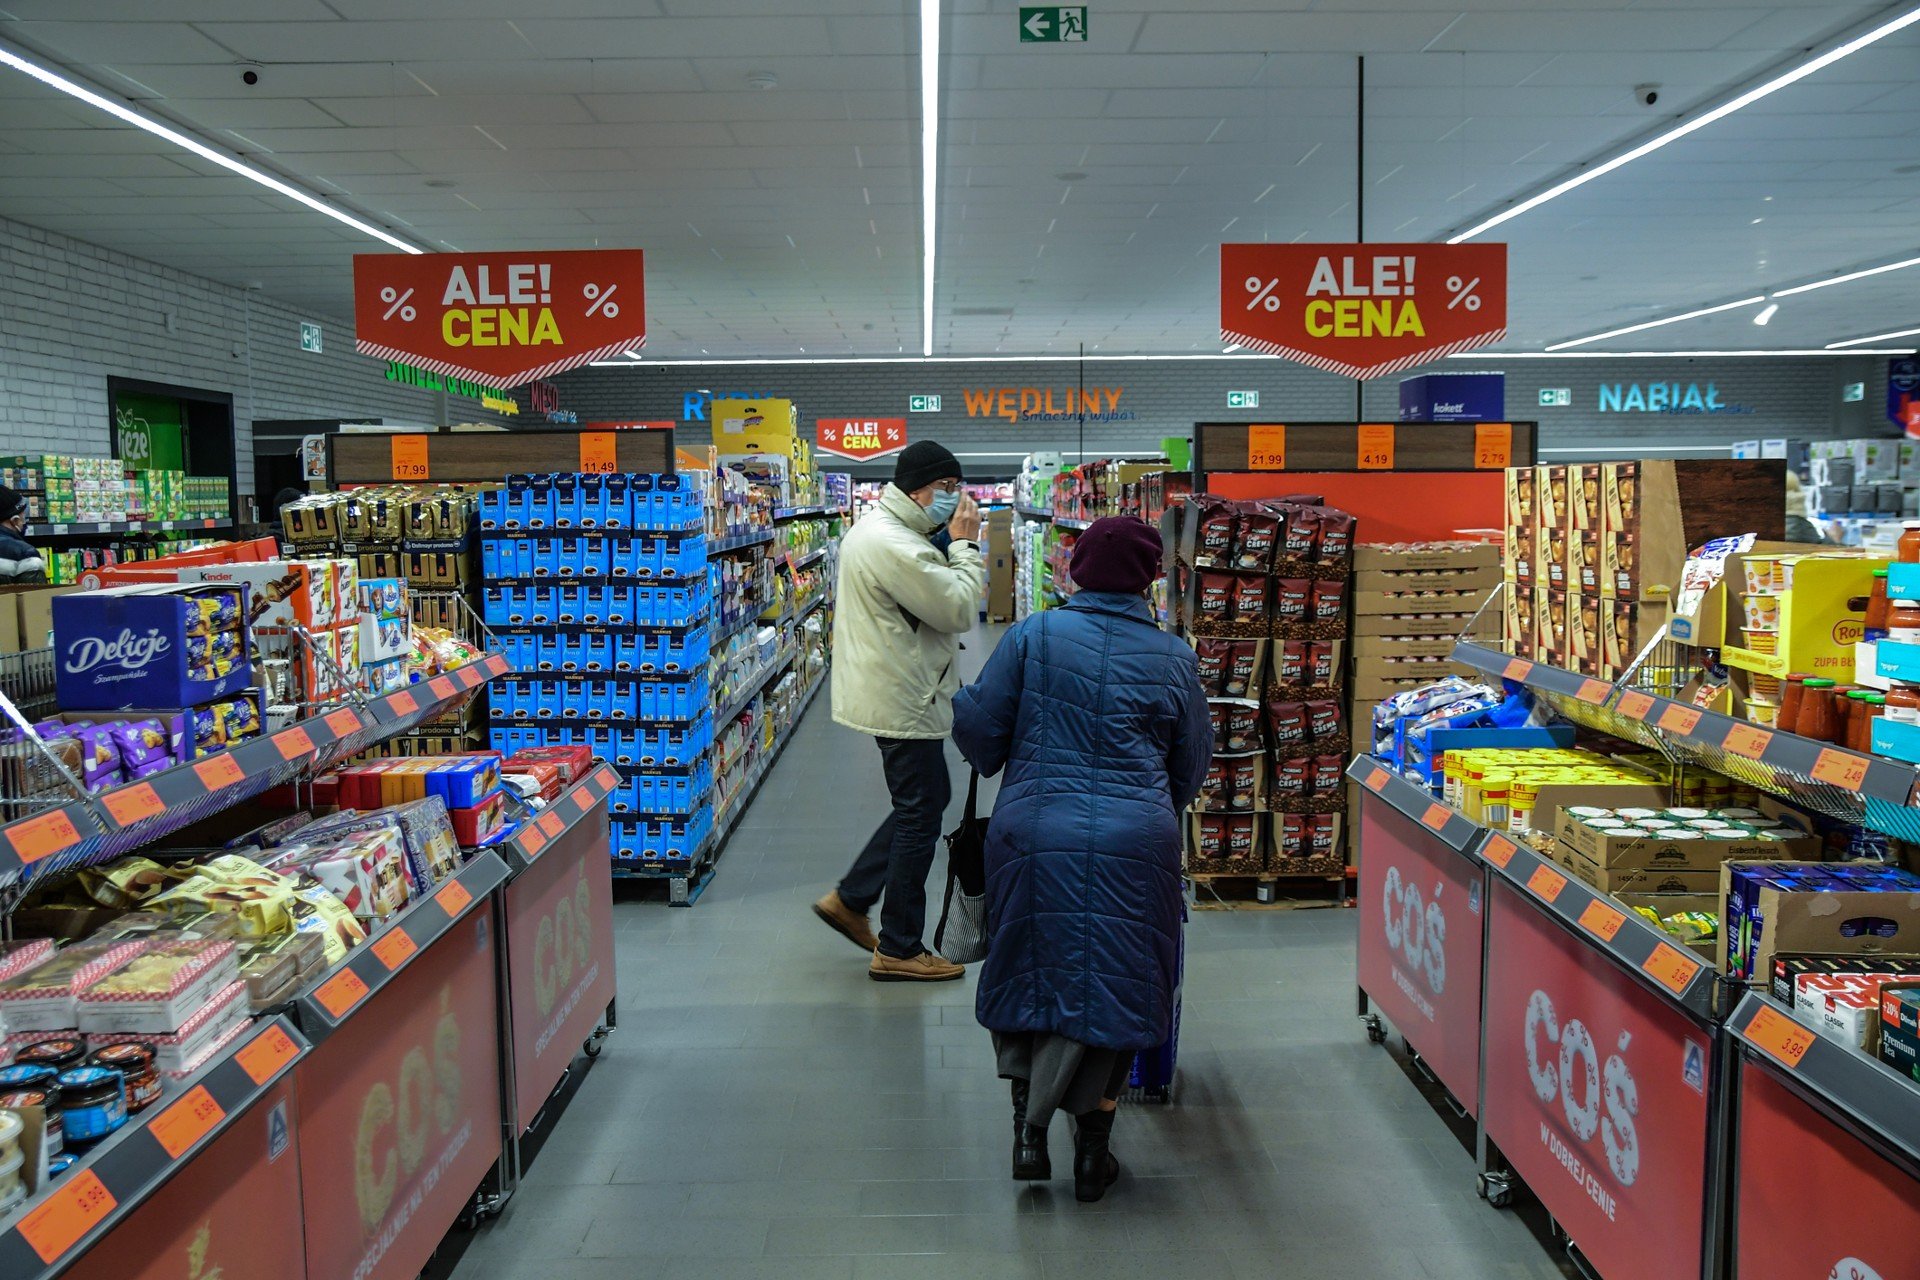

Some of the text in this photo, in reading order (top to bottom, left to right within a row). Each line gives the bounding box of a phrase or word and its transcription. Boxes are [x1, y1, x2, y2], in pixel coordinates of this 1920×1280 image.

[1305, 256, 1416, 297] ALE!
[442, 264, 551, 305] ALE!
[1305, 299, 1426, 338] CENA
[442, 308, 564, 347] CENA
[1599, 380, 1726, 412] NABIAŁ
[962, 386, 1124, 424] WĘDLINY
[843, 422, 878, 436] ALE!
[842, 436, 881, 449] CENA
[583, 462, 615, 473] 11,49
[1251, 455, 1282, 466] 21,99
[395, 464, 426, 476] 17,99
[296, 543, 328, 552] prodomo
[1205, 537, 1229, 545] CREMA
[1322, 545, 1346, 553] CREMA
[1202, 600, 1226, 608] CREMA
[1239, 601, 1263, 610] CREMA
[1280, 605, 1304, 613] CREMA
[1839, 626, 1864, 640] ROL
[65, 628, 171, 674] Delicje
[1814, 657, 1838, 668] ZUPA
[94, 670, 148, 685] Szampańskie
[420, 727, 452, 736] prodomo
[1316, 778, 1339, 787] CREMA
[1843, 768, 1863, 783] 2,49
[1279, 779, 1302, 787] CREMA
[1824, 1014, 1845, 1030] CLASSIC
[1781, 1038, 1804, 1058] 3,99
[1883, 1030, 1916, 1058] Premium
[1884, 1042, 1896, 1058] Tea
[1549, 1136, 1583, 1188] DOBREJ
[1585, 1175, 1617, 1222] CENIE
